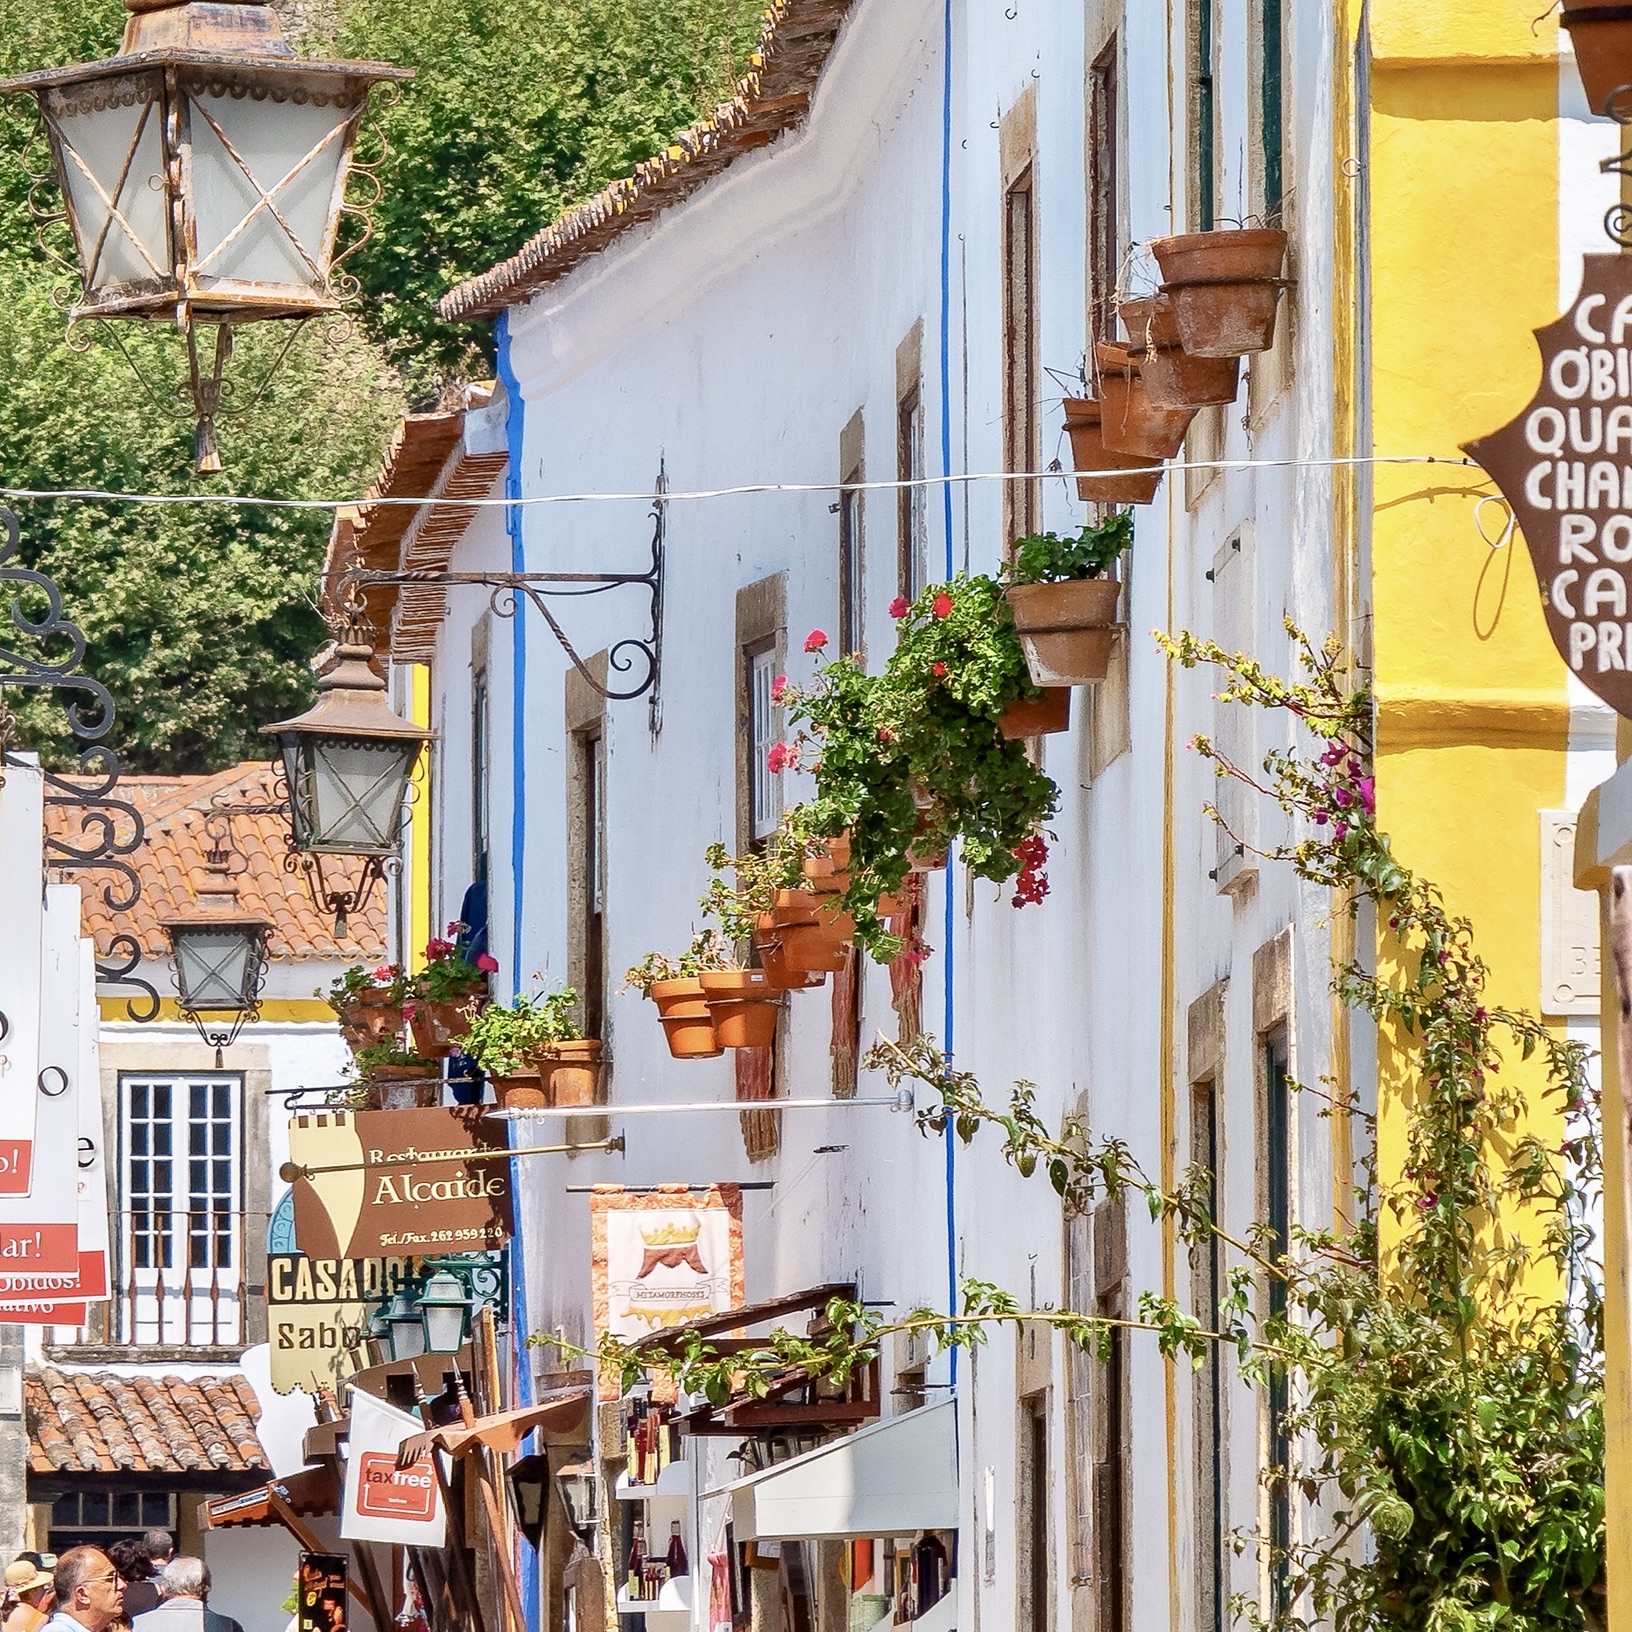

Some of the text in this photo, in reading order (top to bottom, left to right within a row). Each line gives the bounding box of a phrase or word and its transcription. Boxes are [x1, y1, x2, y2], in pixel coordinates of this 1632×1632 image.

[371, 1168, 505, 1205] Alcaide
[271, 1257, 358, 1301] CASA
[365, 1468, 432, 1488] taxfree
